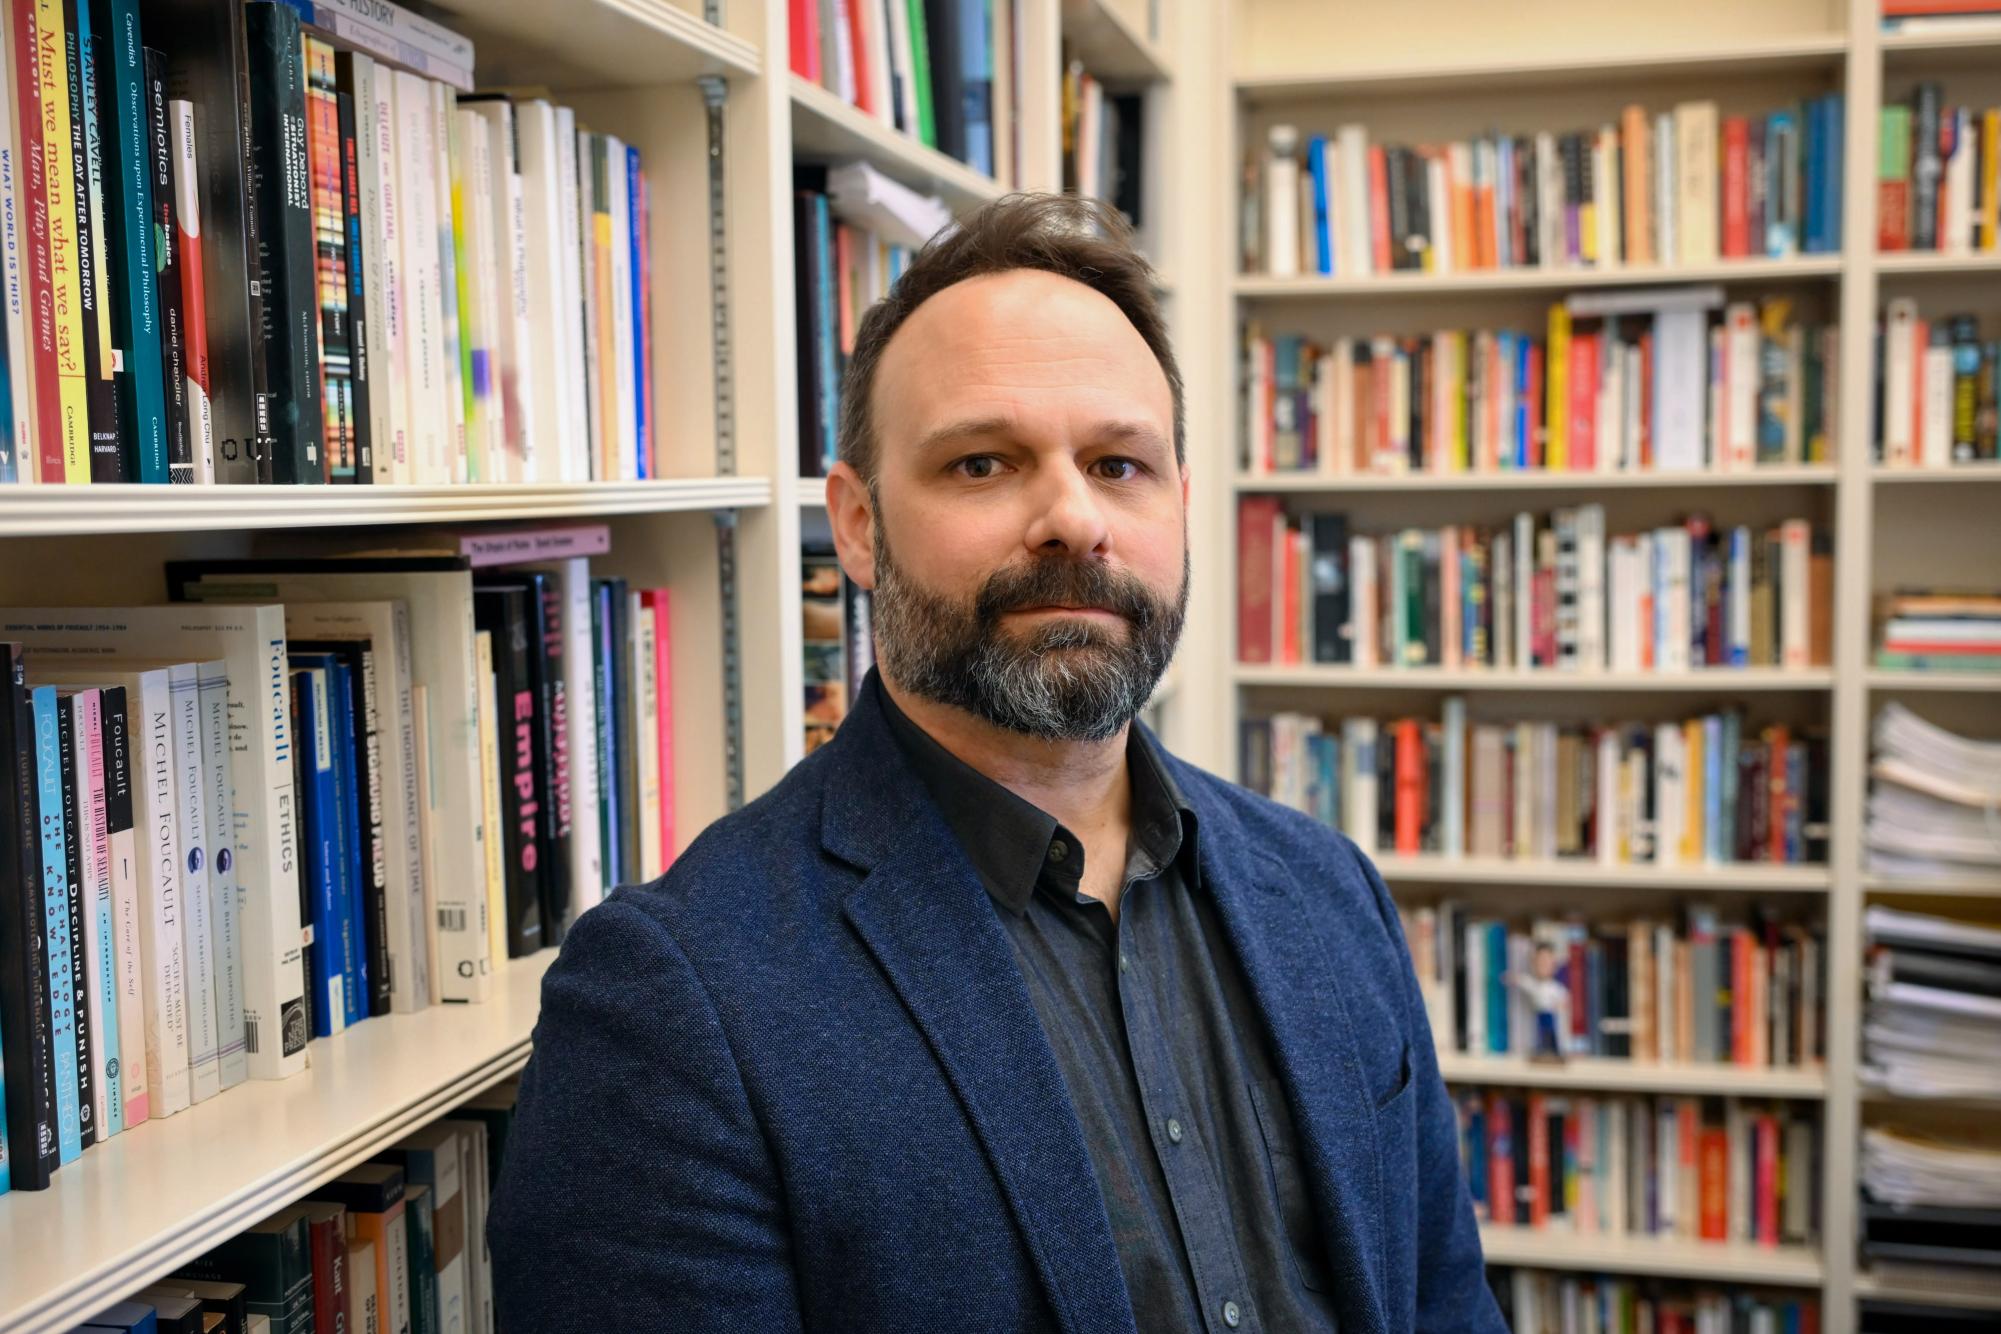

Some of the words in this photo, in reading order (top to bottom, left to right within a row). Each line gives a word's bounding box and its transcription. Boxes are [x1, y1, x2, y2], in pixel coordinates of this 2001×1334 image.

[126, 12, 136, 68] Cavendish
[350, 0, 395, 26] HISTORY
[28, 13, 40, 98] CAILLOIS
[40, 28, 57, 89] Must
[66, 32, 81, 119] PHILOSOPHY
[83, 38, 96, 115] STANLEY
[46, 101, 56, 132] we
[73, 124, 82, 150] THE
[130, 82, 141, 158] Observations
[154, 79, 169, 187] semiotics
[184, 114, 194, 160] Females
[2, 150, 12, 191] WHAT
[30, 139, 42, 190] Man,
[48, 141, 61, 206] mean
[73, 155, 83, 182] DAY
[88, 123, 101, 186] CAVELL
[135, 160, 143, 190] upon
[283, 114, 293, 207] INTERNATIONAL
[291, 121, 301, 209] SITUATIONIST
[298, 151, 310, 209] Debord
[5, 197, 16, 250] WORLD
[32, 198, 47, 241] Play
[77, 183, 87, 225] AFTER
[137, 192, 150, 267] Experimental
[383, 184, 395, 240] GUATTARI
[9, 256, 17, 269] IS
[38, 243, 51, 284] and
[52, 217, 70, 274] what
[80, 228, 93, 311] TOMORROW
[10, 275, 20, 315] THIS?
[40, 290, 52, 352] Games
[57, 284, 67, 316] we
[142, 269, 153, 335] Philosophy
[59, 325, 77, 372] say?
[169, 308, 179, 348] daniel
[172, 351, 183, 407] chandler
[358, 354, 366, 382] Delany
[67, 405, 76, 466] CAMBRIDGE
[93, 432, 117, 441] BELKNAP
[94, 445, 117, 454] HARVARD
[152, 416, 160, 471] CAMBRIDGE
[270, 638, 289, 763] Foucault
[401, 689, 410, 716] THE
[41, 714, 56, 794] FOUCAULT
[60, 708, 69, 775] MICHEL
[90, 733, 103, 777] FOUCAULT
[113, 713, 126, 796] Foucault
[184, 700, 196, 758] MICHEL
[211, 702, 222, 758] MICHEL
[153, 711, 169, 804] MICHEL
[366, 735, 384, 824] SIGMUND
[402, 723, 417, 828] INORDINANCE
[514, 690, 538, 872] Empire
[23, 802, 31, 827] AND
[93, 788, 105, 805] THE
[95, 807, 108, 842] HISTORY
[188, 766, 200, 841] FOUCAULT
[215, 765, 226, 838] FOUCAULT
[25, 830, 33, 849] BEC
[44, 815, 52, 841] OF
[54, 813, 62, 851] THE
[64, 785, 76, 875] FOUCAULT
[97, 844, 107, 855] OF
[279, 794, 293, 873] ETHICS
[408, 835, 417, 853] OF
[98, 856, 110, 901] SEXUALITY
[159, 812, 175, 927] FOUCAULT
[371, 826, 385, 888] FREUD
[410, 857, 421, 896] TIME
[46, 865, 62, 1036] KNOWLEDGE
[56, 874, 71, 1031] ARCHAEOLOGY
[69, 883, 82, 982] DISCIPLINE
[76, 990, 84, 1001] &
[227, 965, 235, 1031] BIOPOLITICS
[77, 1009, 88, 1089] PUNISH
[333, 1255, 343, 1296] Kant
